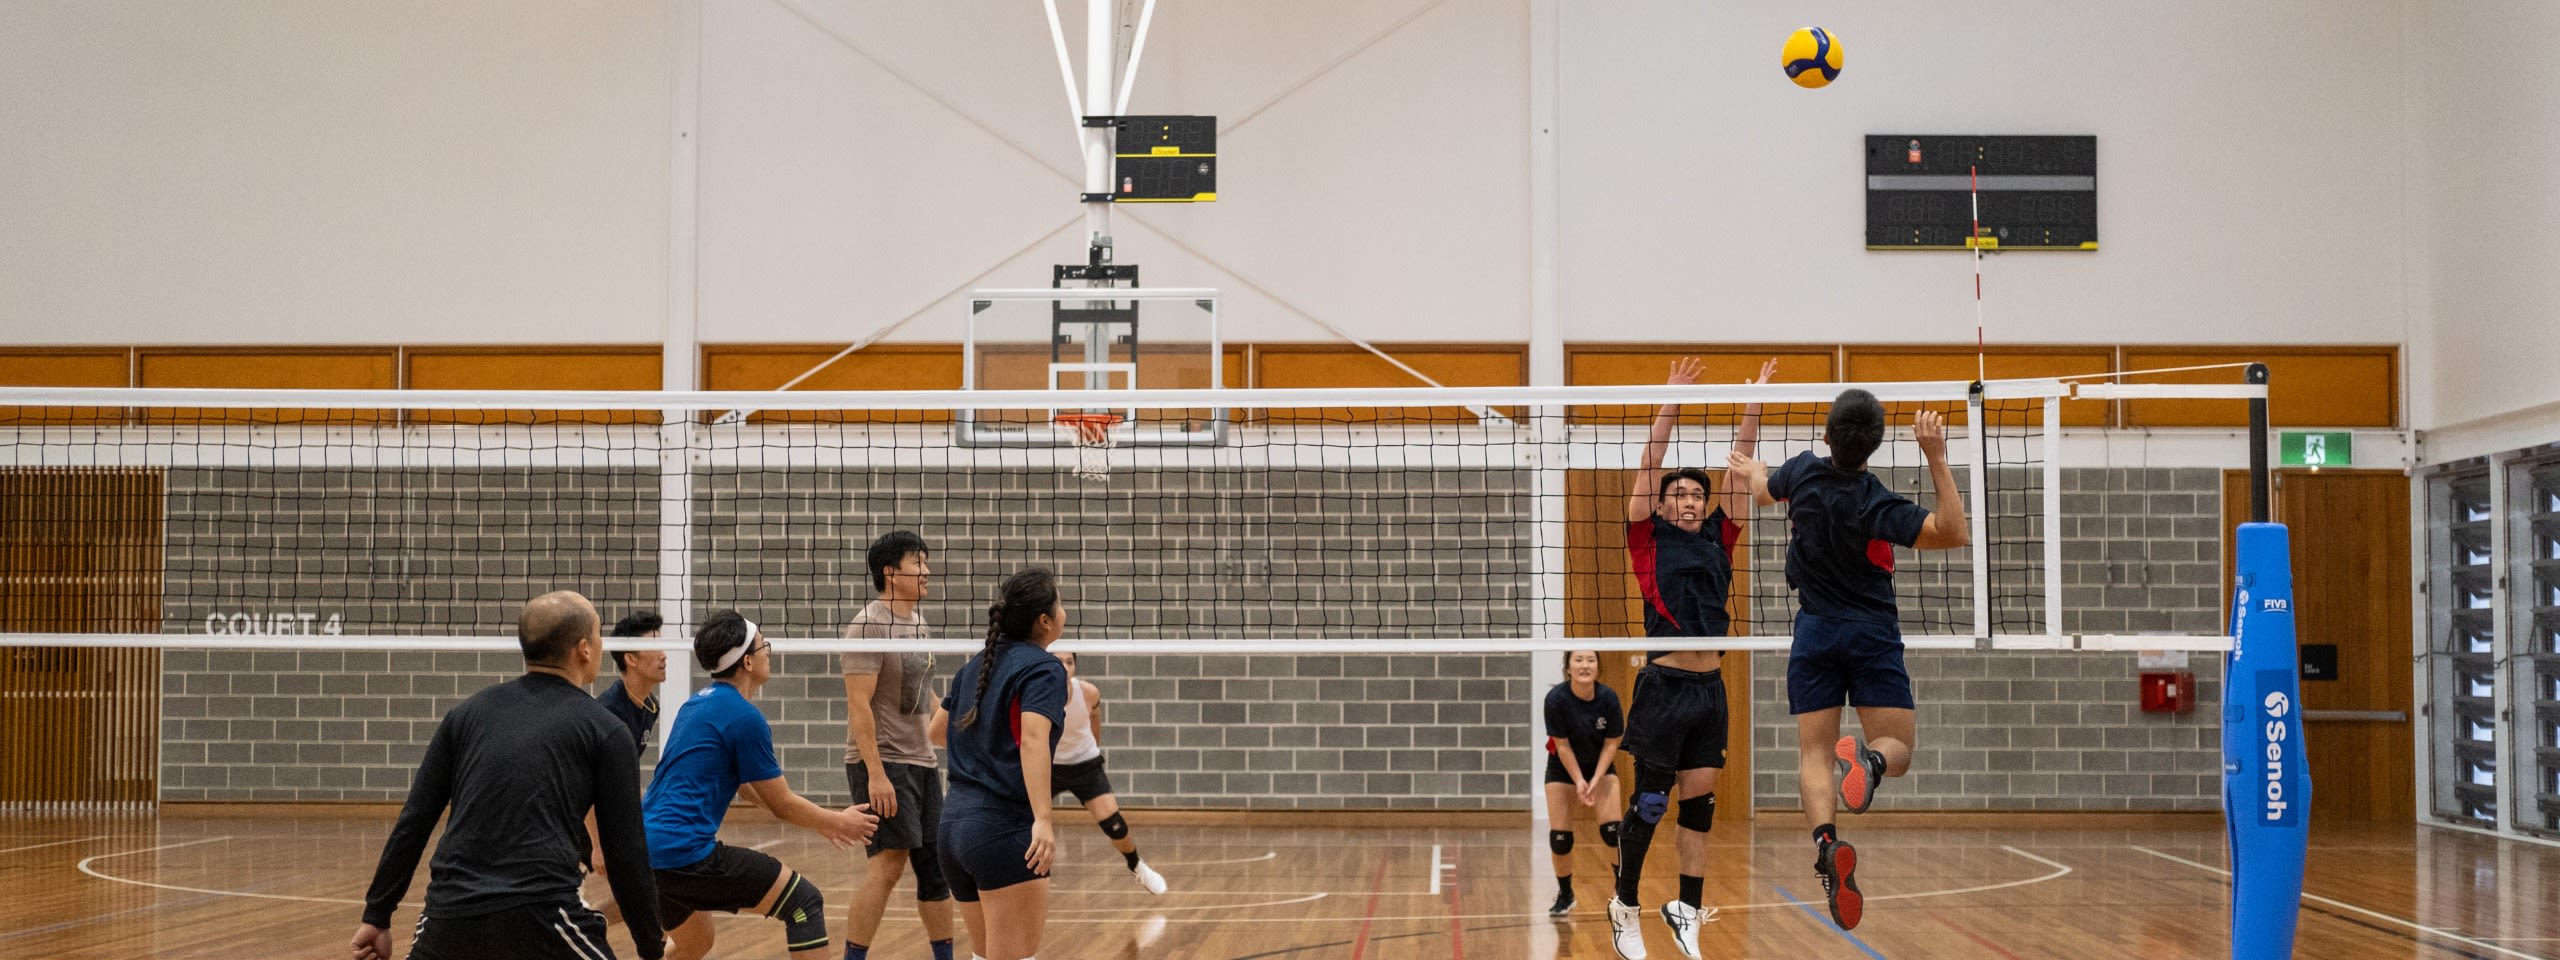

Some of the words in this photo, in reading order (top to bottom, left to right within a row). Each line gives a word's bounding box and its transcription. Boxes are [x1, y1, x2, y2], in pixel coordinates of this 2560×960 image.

[2264, 598, 2287, 609] FIVB
[205, 612, 316, 636] COURT
[323, 612, 343, 636] 4
[2234, 607, 2246, 661] Senoh
[2266, 720, 2288, 821] Senoh
